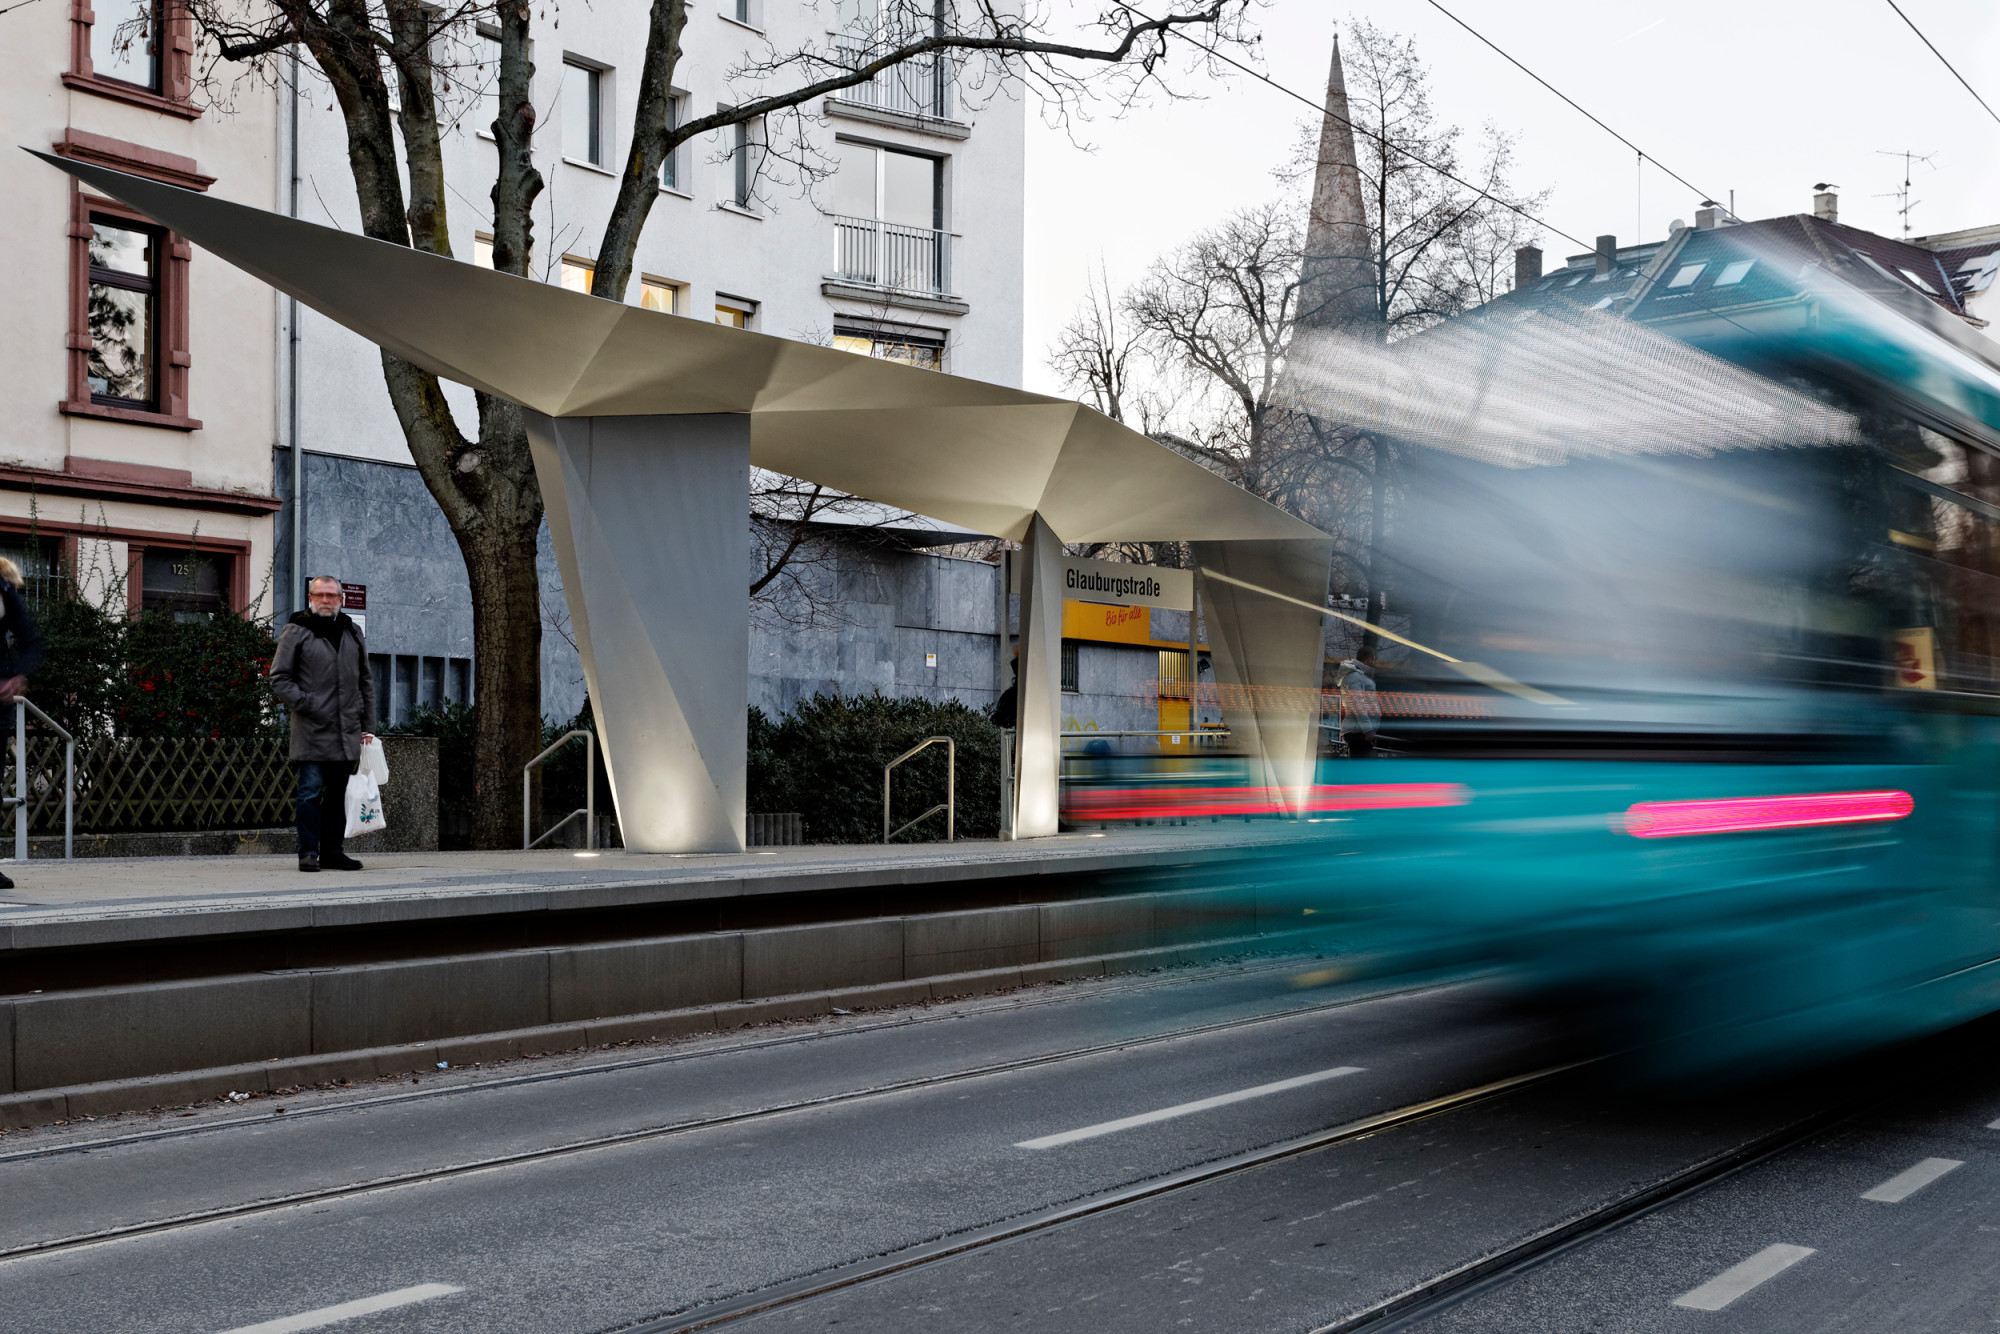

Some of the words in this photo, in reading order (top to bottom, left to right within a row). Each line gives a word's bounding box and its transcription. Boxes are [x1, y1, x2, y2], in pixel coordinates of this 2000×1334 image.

[172, 564, 189, 575] 125
[1066, 568, 1160, 597] Glauburgstraße
[1105, 610, 1117, 627] Bio
[1118, 608, 1128, 626] für
[1129, 605, 1142, 620] alle
